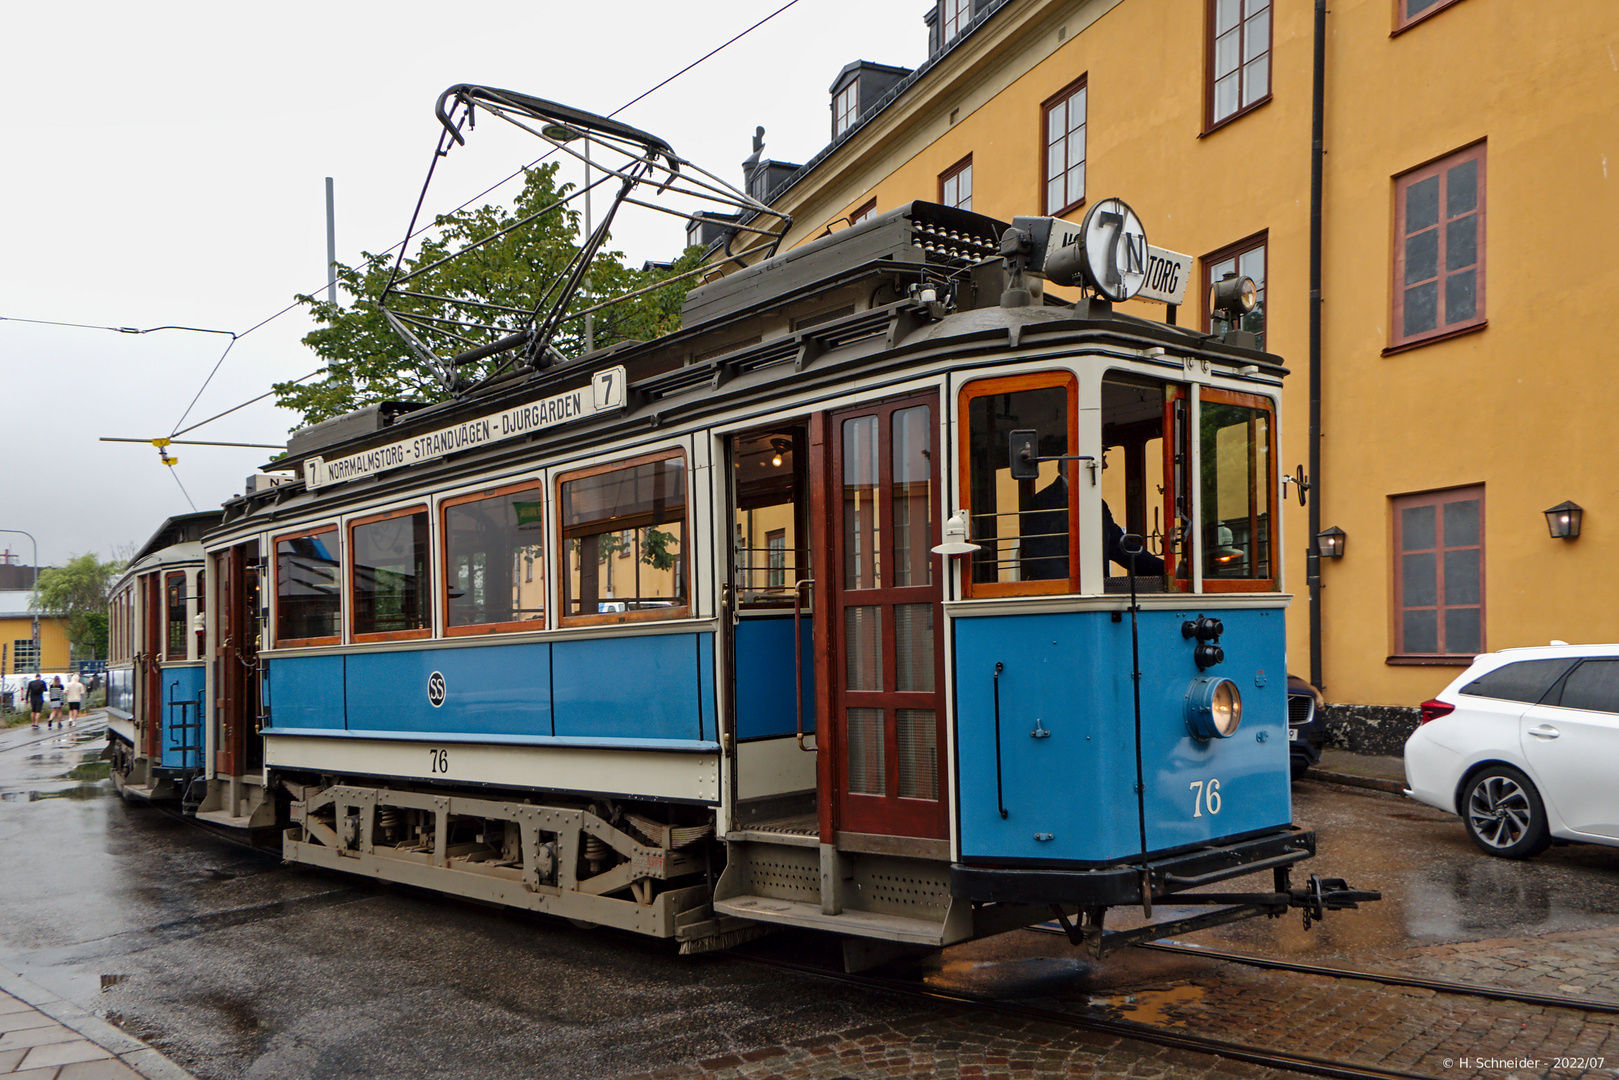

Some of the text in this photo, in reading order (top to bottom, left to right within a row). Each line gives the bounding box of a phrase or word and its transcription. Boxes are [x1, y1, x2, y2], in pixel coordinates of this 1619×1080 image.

[309, 462, 316, 485] 7
[328, 445, 404, 481] NORRMALMSTORG
[413, 419, 490, 458] STRANDVÄGEN
[502, 392, 581, 435] DJURGÅRDEN
[601, 374, 613, 405] 7
[429, 749, 448, 774] 76
[1189, 778, 1222, 818] 76
